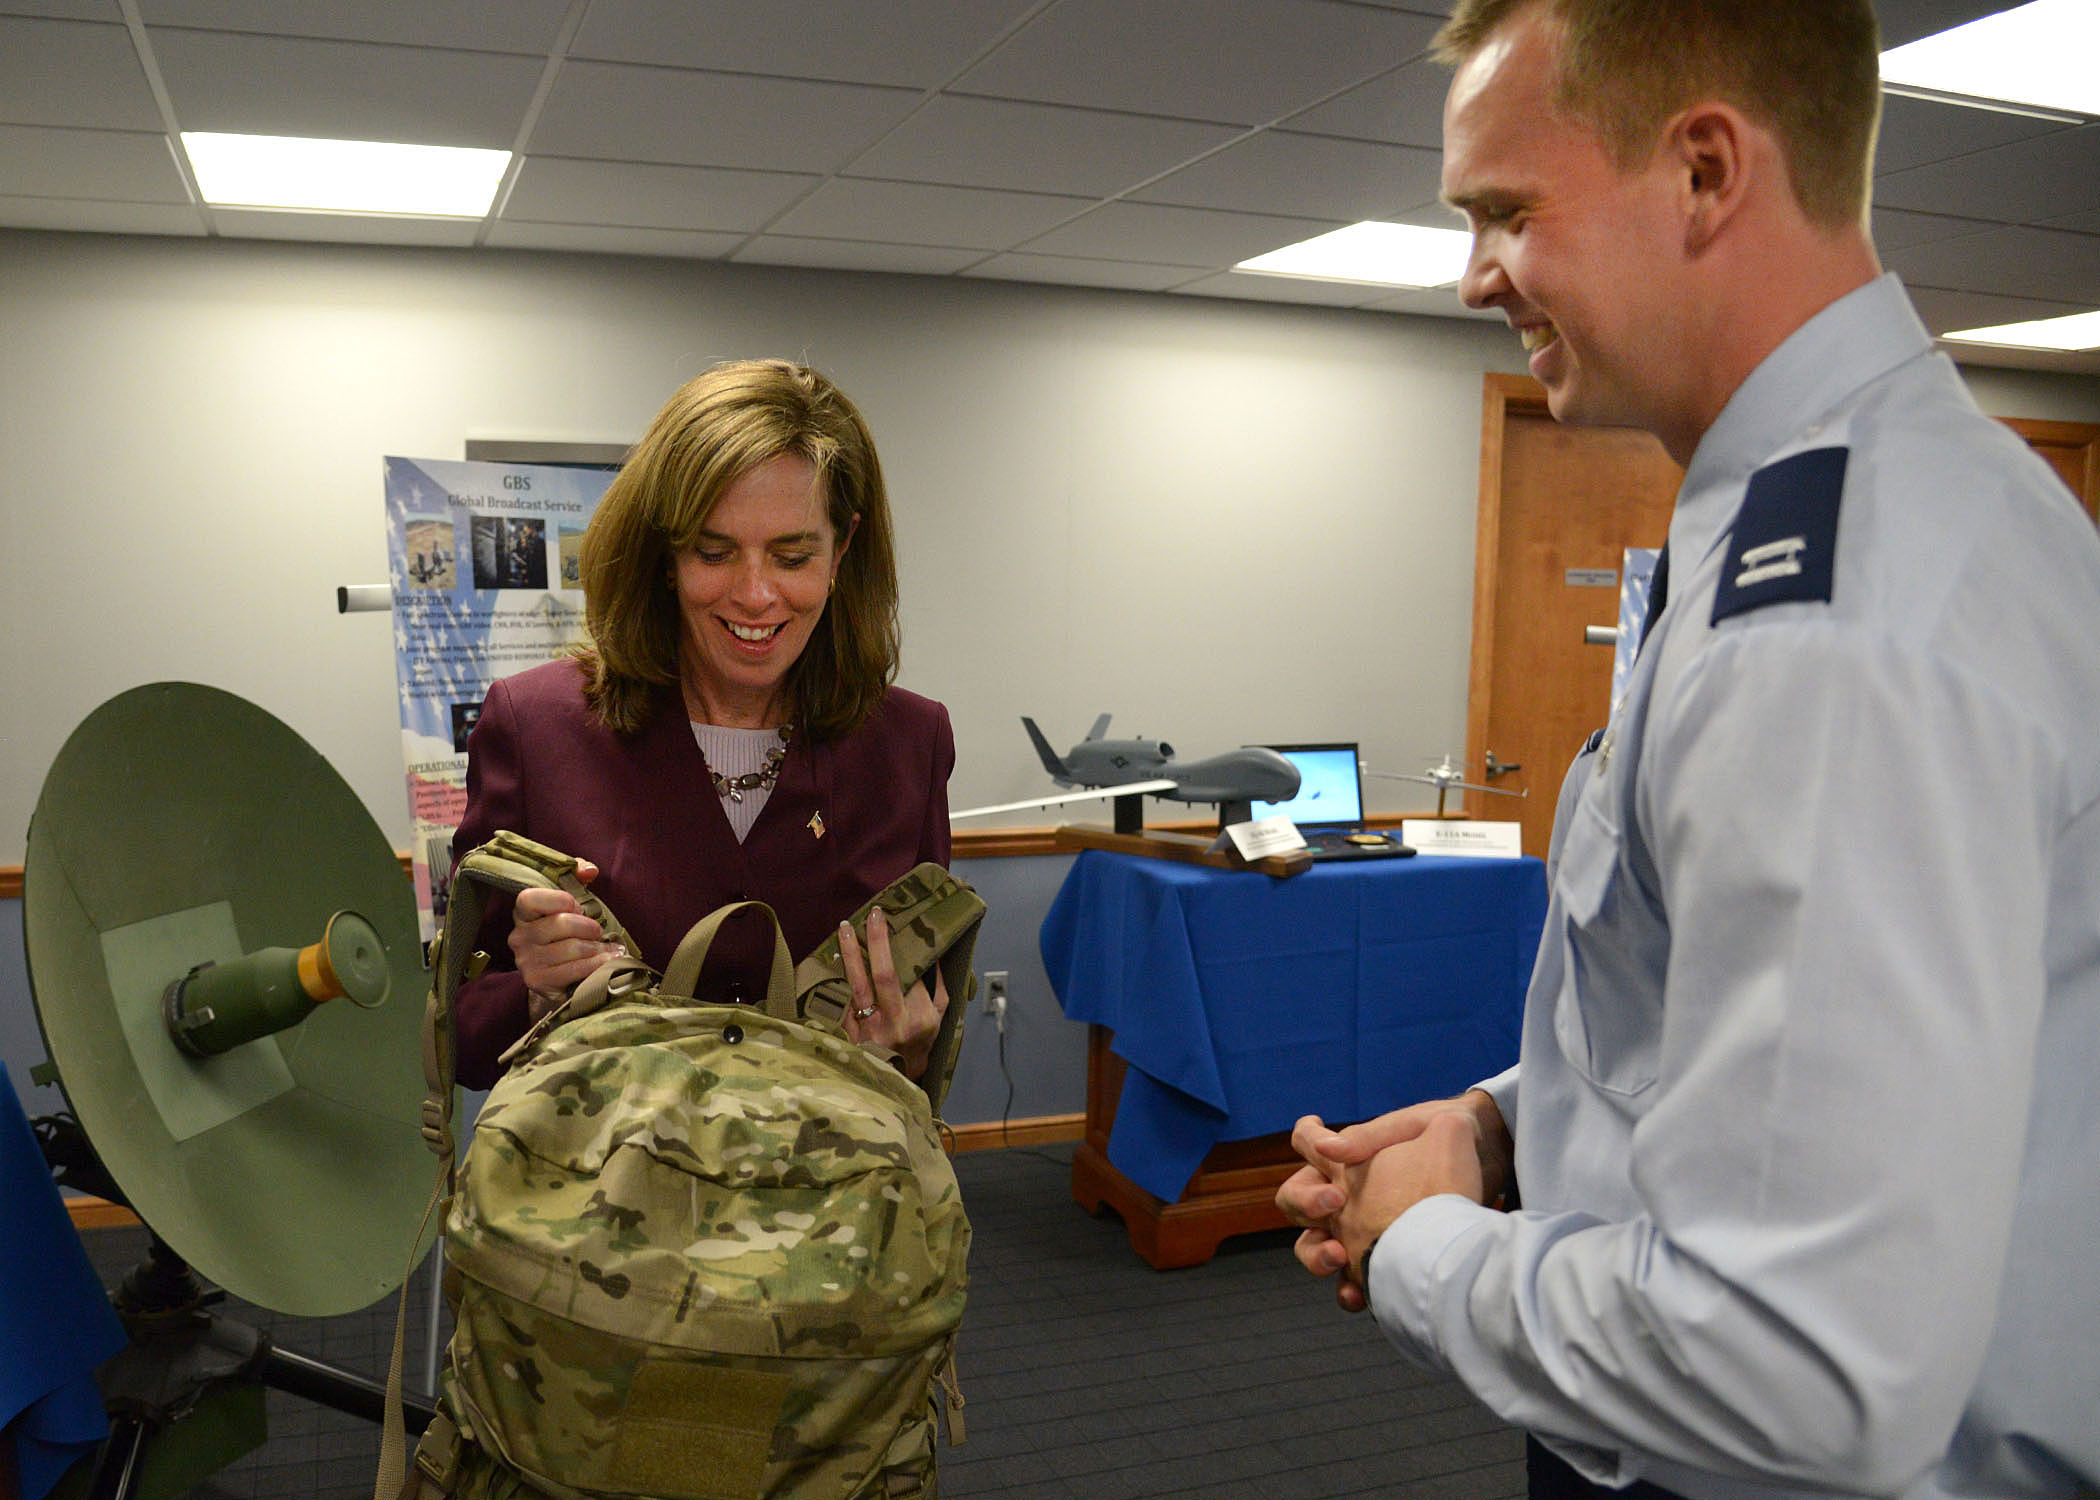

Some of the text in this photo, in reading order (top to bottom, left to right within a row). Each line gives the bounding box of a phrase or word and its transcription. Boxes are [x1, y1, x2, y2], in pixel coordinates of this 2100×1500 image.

[503, 475, 531, 490] GBS
[448, 495, 583, 512] Global Broadcast Service
[408, 760, 466, 774] OPERATIONAL
